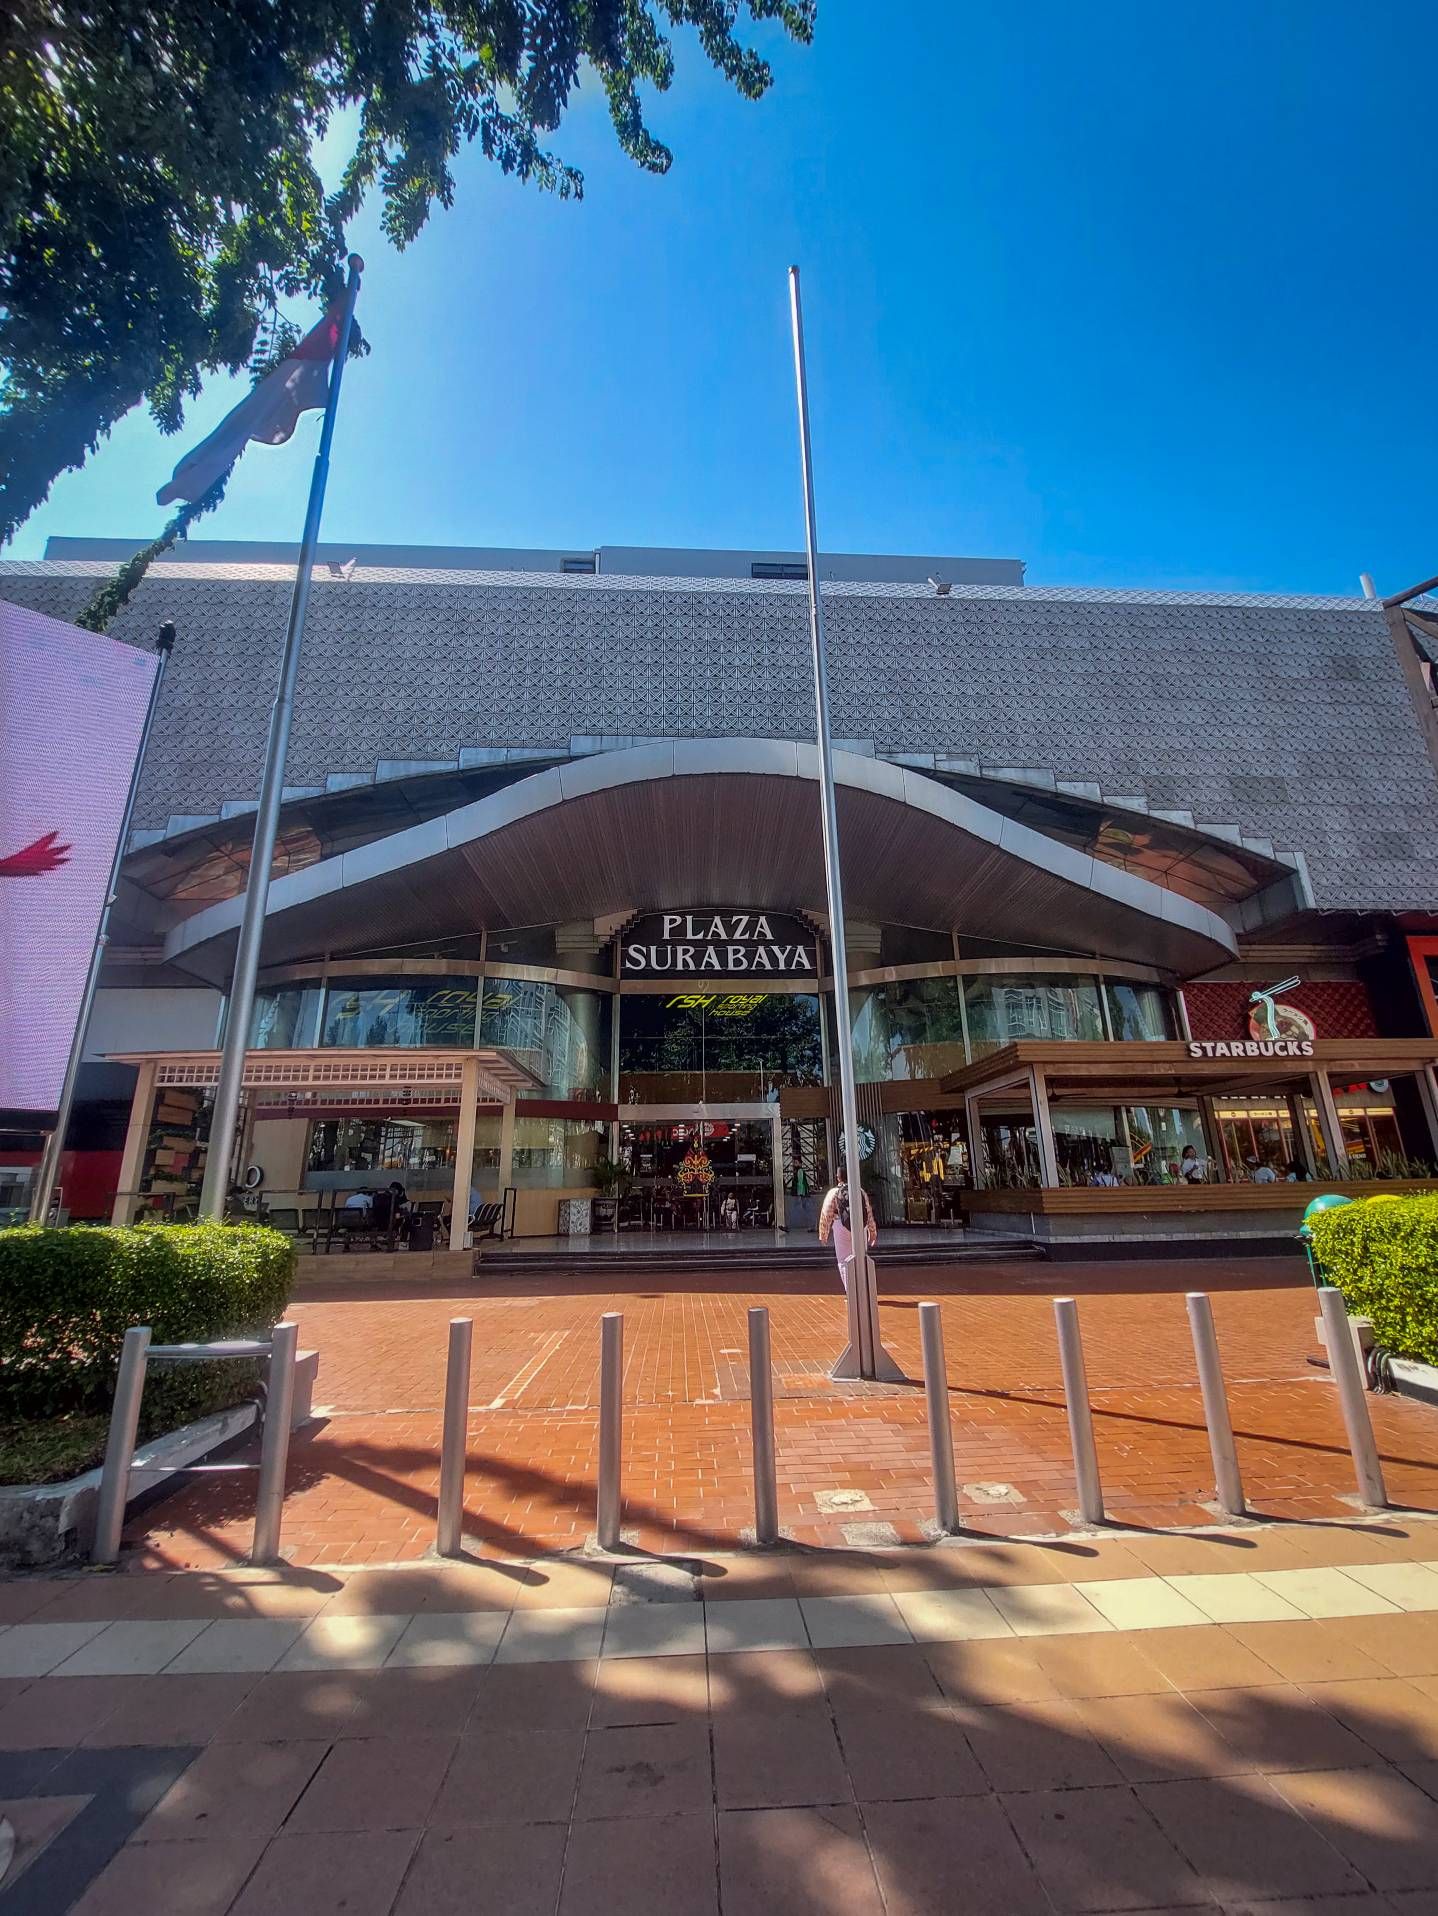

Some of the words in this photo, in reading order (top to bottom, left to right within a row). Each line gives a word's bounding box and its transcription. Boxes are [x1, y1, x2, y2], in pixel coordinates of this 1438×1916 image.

[661, 915, 775, 940] PLAZA
[625, 944, 812, 971] SURABAYA
[721, 994, 769, 1004] royal
[1188, 1040, 1314, 1058] STARBUCKS
